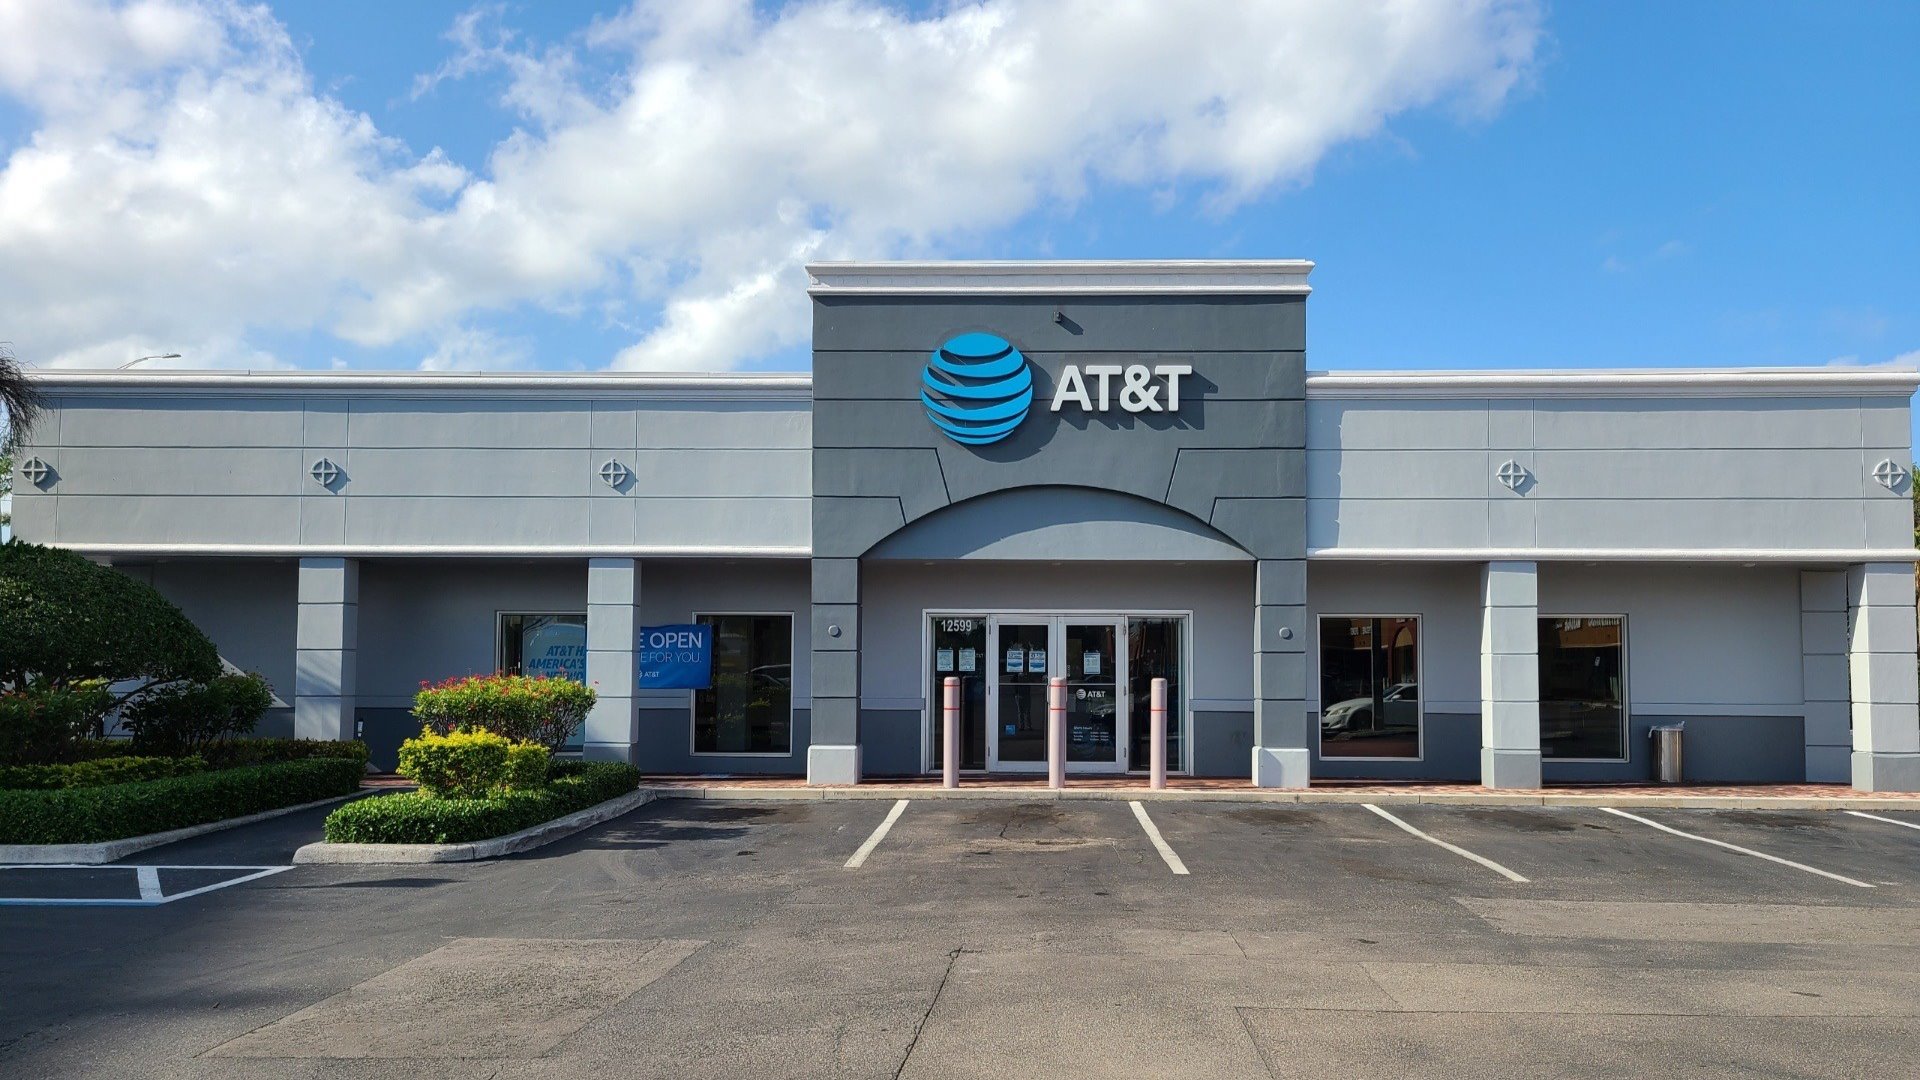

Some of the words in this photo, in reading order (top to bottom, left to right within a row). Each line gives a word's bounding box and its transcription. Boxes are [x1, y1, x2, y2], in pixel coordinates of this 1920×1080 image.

[1050, 364, 1193, 413] AT&T
[941, 619, 972, 632] 12599
[649, 632, 702, 649] OPEN
[546, 645, 574, 657] AT&T
[649, 651, 673, 663] FOR
[674, 651, 702, 663] YOU.
[528, 658, 585, 669] AMERICA'S
[1087, 690, 1106, 698] AT&T
